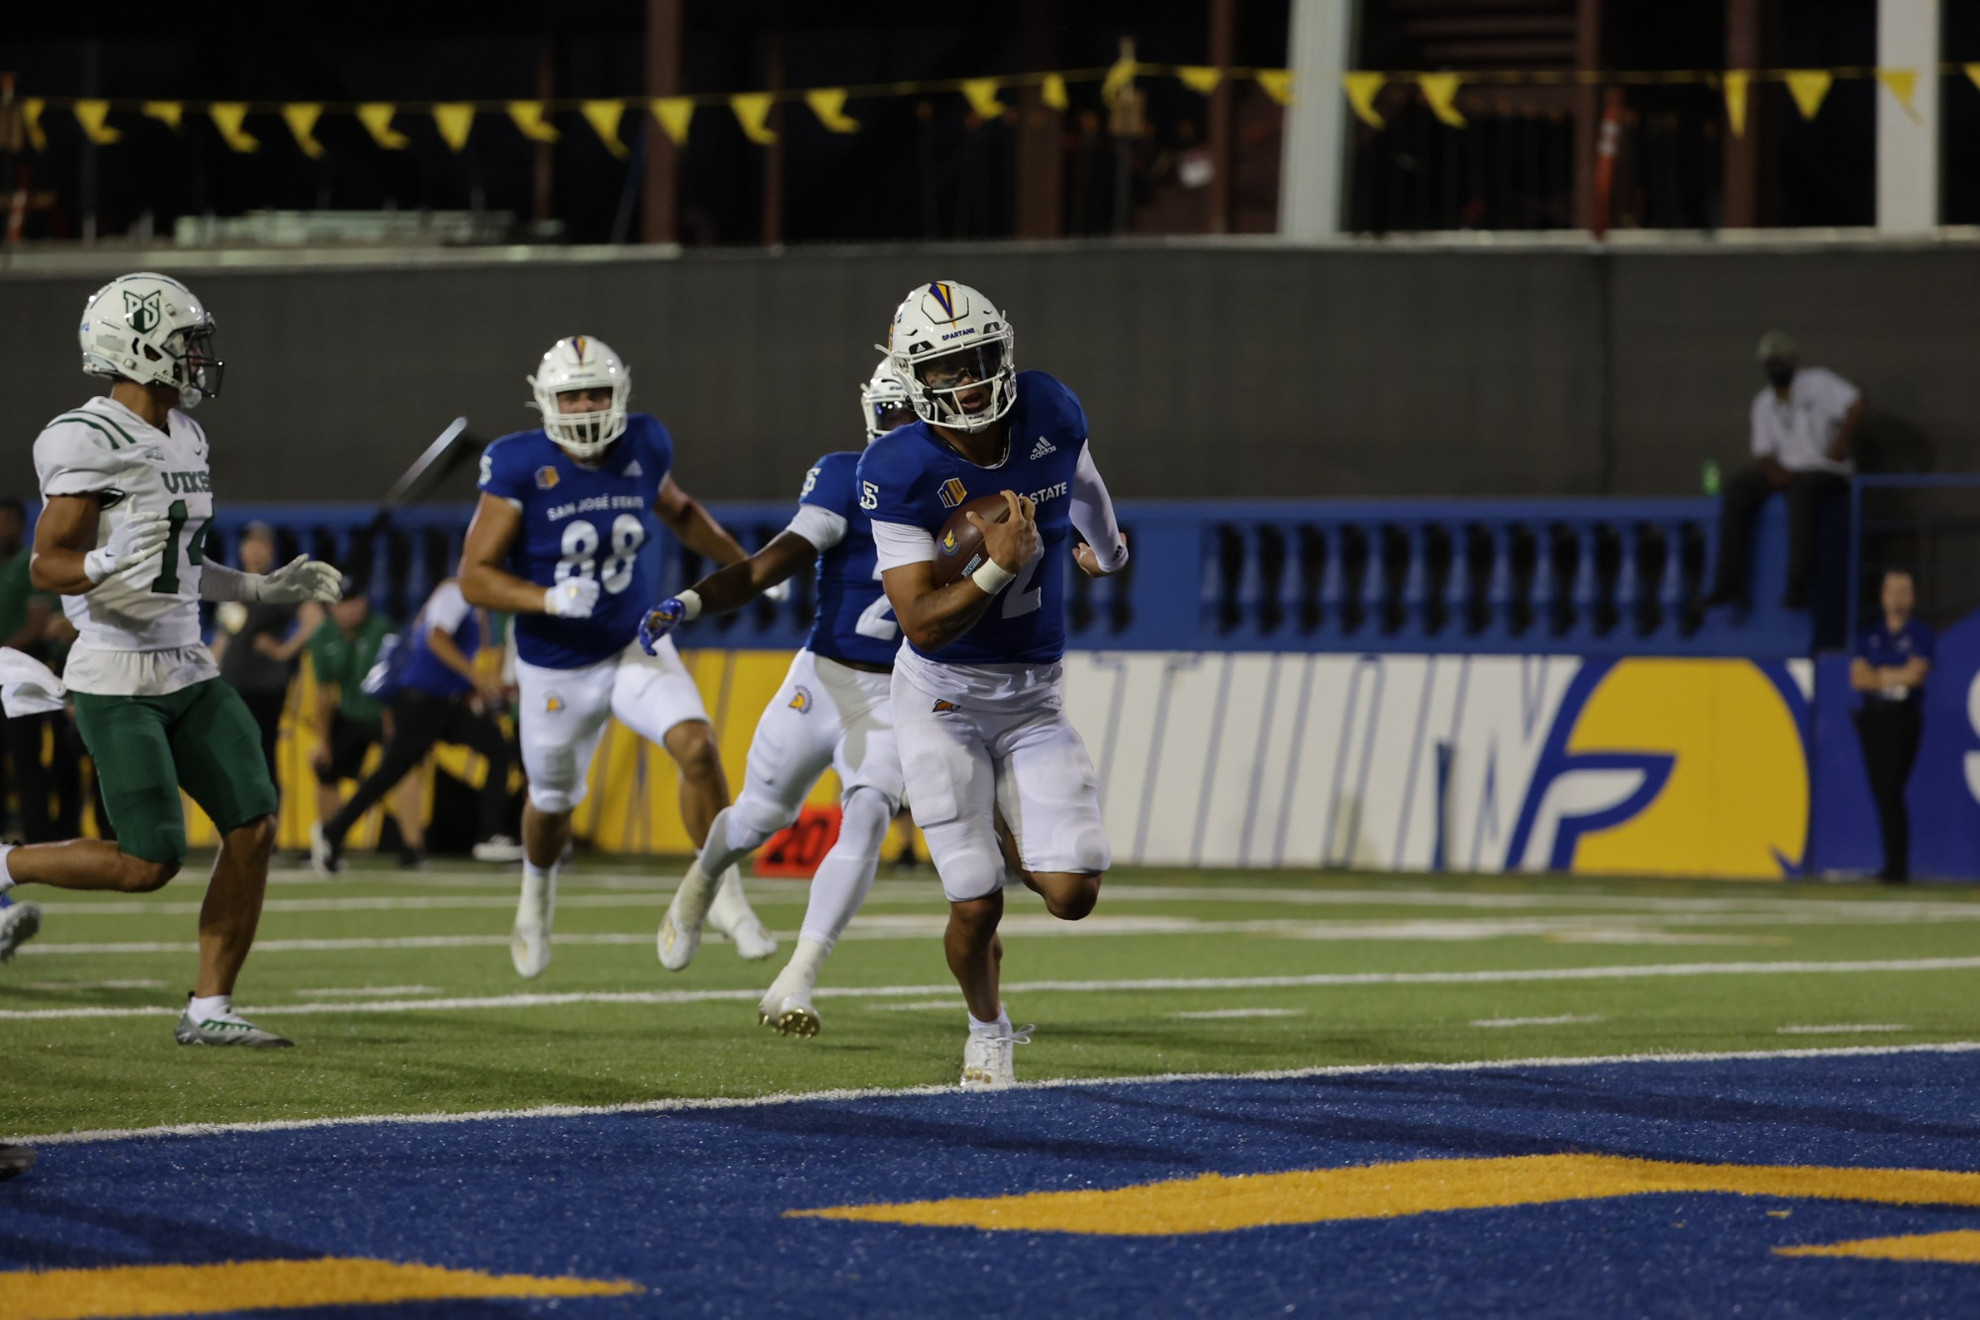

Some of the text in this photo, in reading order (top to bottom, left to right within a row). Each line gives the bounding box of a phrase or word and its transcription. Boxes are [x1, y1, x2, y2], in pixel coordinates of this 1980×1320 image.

[941, 327, 976, 341] SPARTANS
[1029, 445, 1057, 461] adidas
[1029, 481, 1068, 506] STATE
[546, 493, 645, 522] SAN JOSÉ STATE
[553, 513, 646, 595] 88
